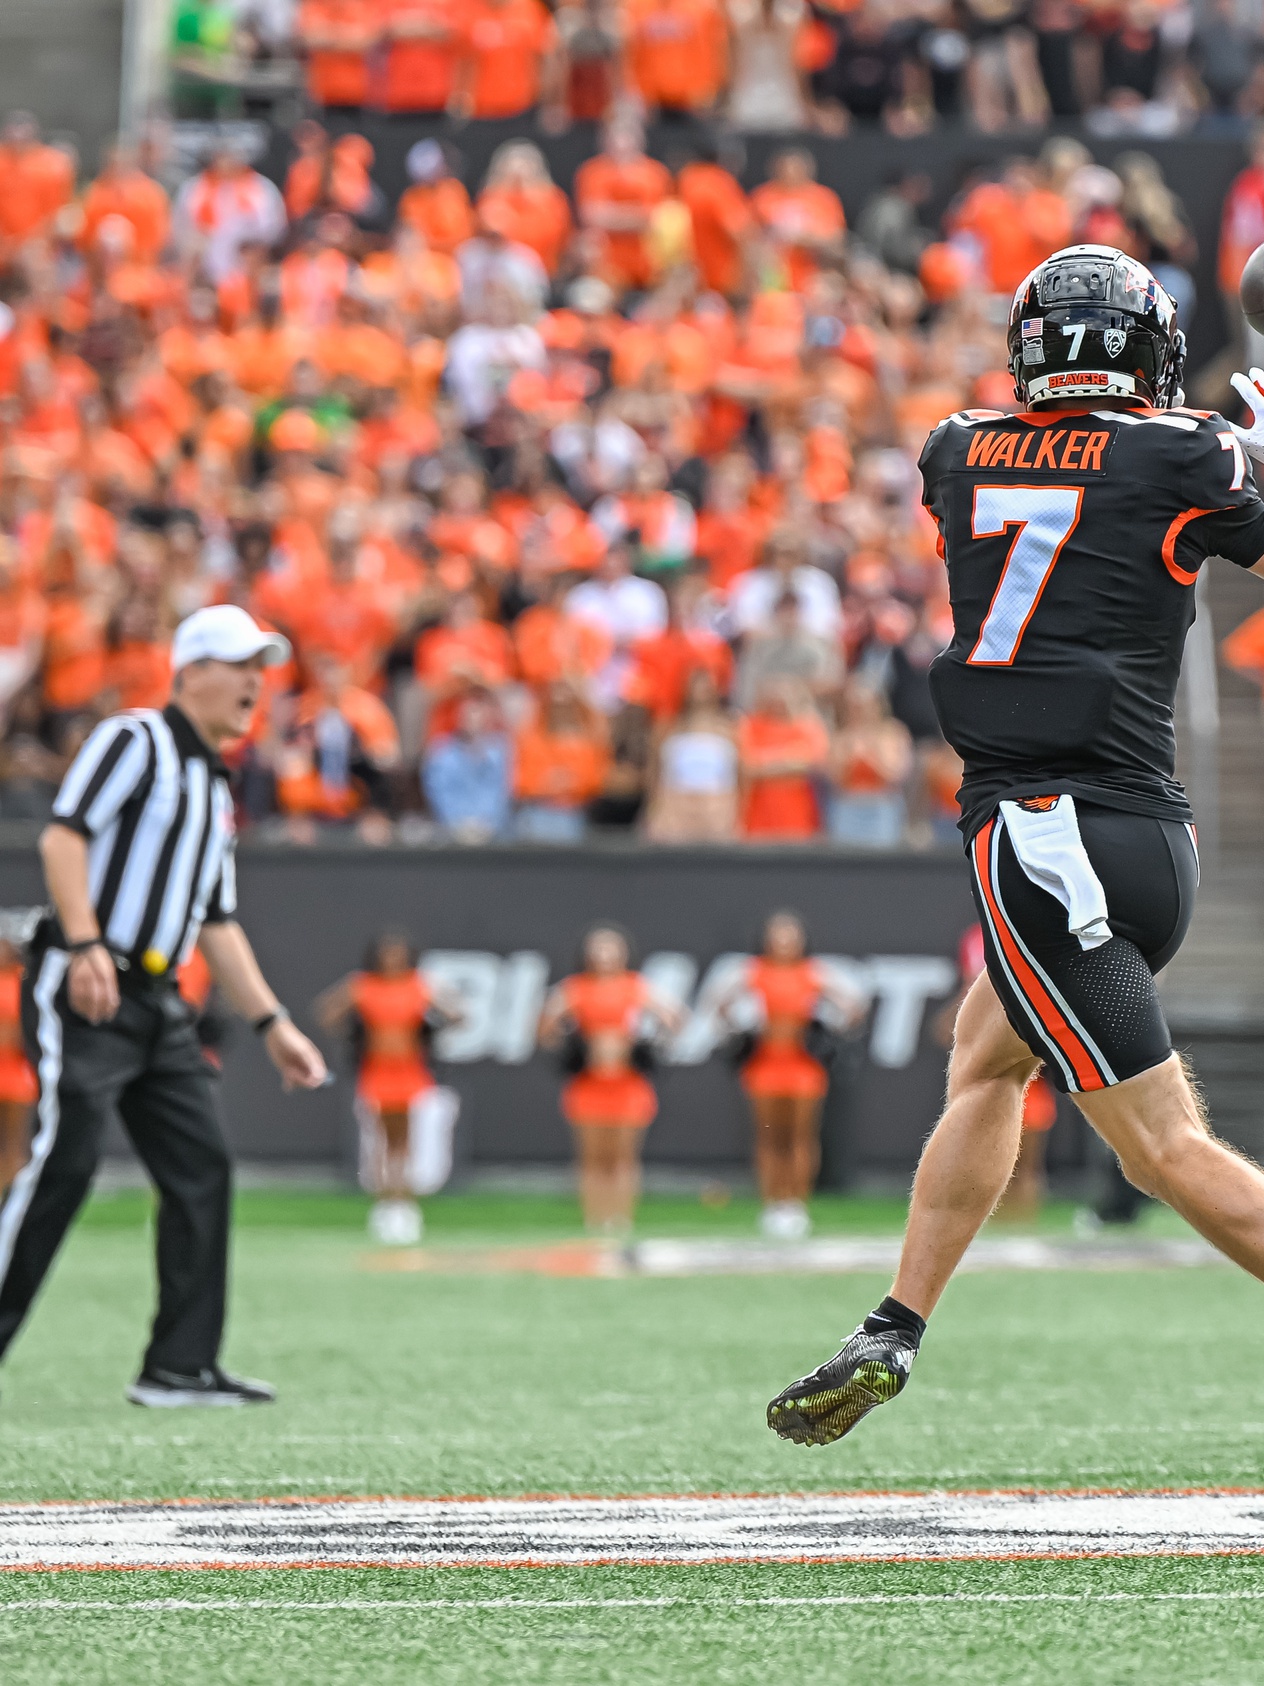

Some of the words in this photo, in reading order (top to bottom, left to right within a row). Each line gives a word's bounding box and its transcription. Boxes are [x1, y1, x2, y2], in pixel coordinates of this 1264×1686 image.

[1062, 324, 1086, 361] 7
[1109, 342, 1121, 352] 12
[1048, 373, 1109, 389] BEAVERS
[966, 430, 1110, 470] WALKER
[1215, 431, 1247, 492] 7
[966, 484, 1085, 666] 7
